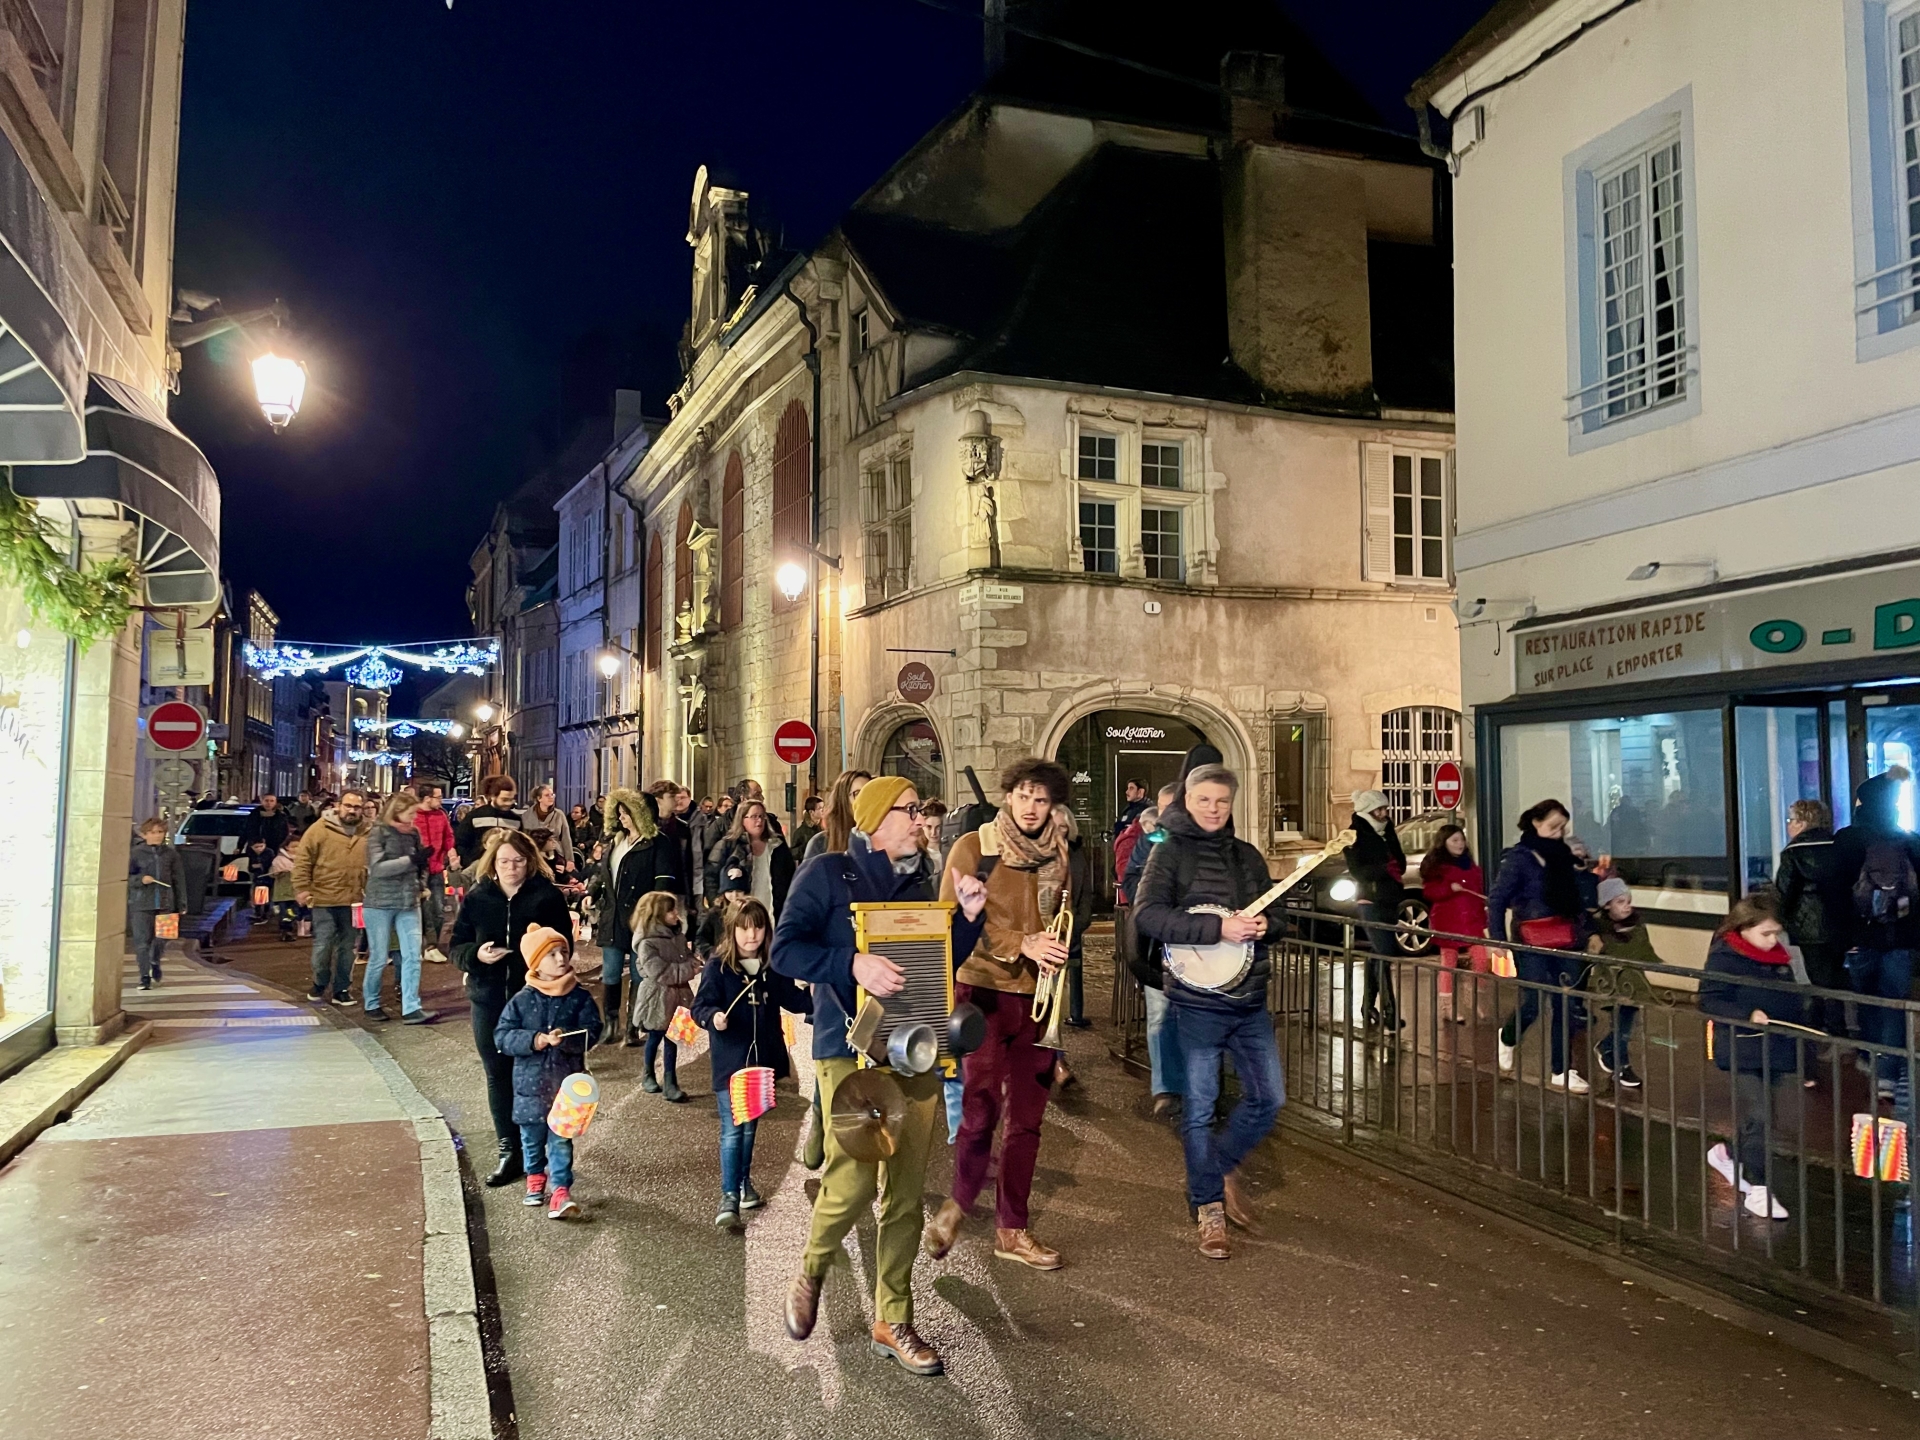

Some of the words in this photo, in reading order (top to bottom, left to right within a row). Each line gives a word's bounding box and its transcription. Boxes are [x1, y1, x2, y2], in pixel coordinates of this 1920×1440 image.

[1525, 627, 1636, 656] RESTAURATION
[1641, 612, 1706, 640] RAPIDE
[906, 671, 927, 682] Soul
[1534, 668, 1555, 687] SUR
[1557, 656, 1594, 679] PLACE
[1616, 643, 1684, 676] EMPORTER
[900, 679, 932, 691] Kitchen
